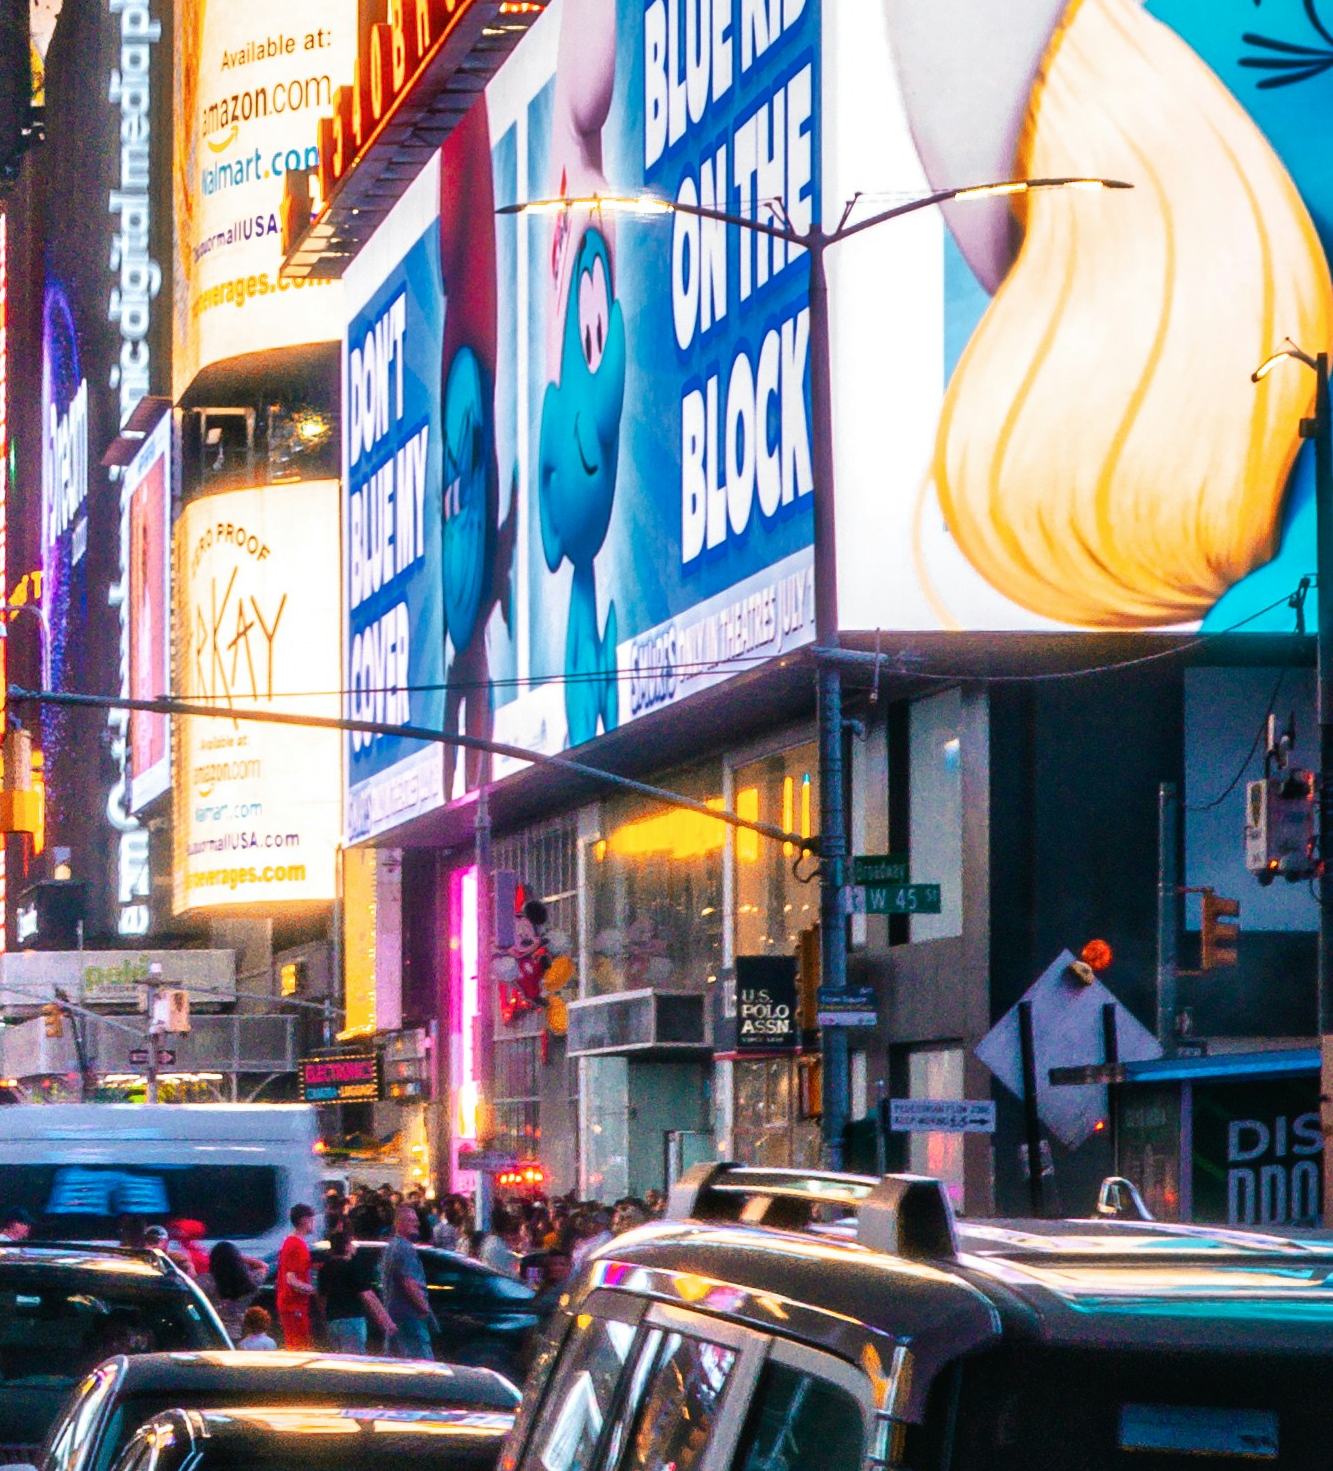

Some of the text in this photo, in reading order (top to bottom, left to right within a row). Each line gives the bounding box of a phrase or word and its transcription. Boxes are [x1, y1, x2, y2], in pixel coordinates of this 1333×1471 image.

[221, 29, 332, 72] Available at:
[202, 73, 332, 140] amazon.com
[672, 61, 811, 351] ON THE
[350, 290, 408, 455] DON'T
[682, 306, 814, 566] BLOCK
[350, 424, 430, 600] BLUE MY
[216, 522, 272, 562] PROOF
[351, 599, 410, 754] COVER
[856, 861, 907, 881] Broadway
[870, 889, 886, 905] W
[895, 890, 918, 910] 45
[741, 988, 773, 1003] U.S.
[741, 1004, 790, 1018] POLO
[740, 1019, 793, 1035] ASSN.
